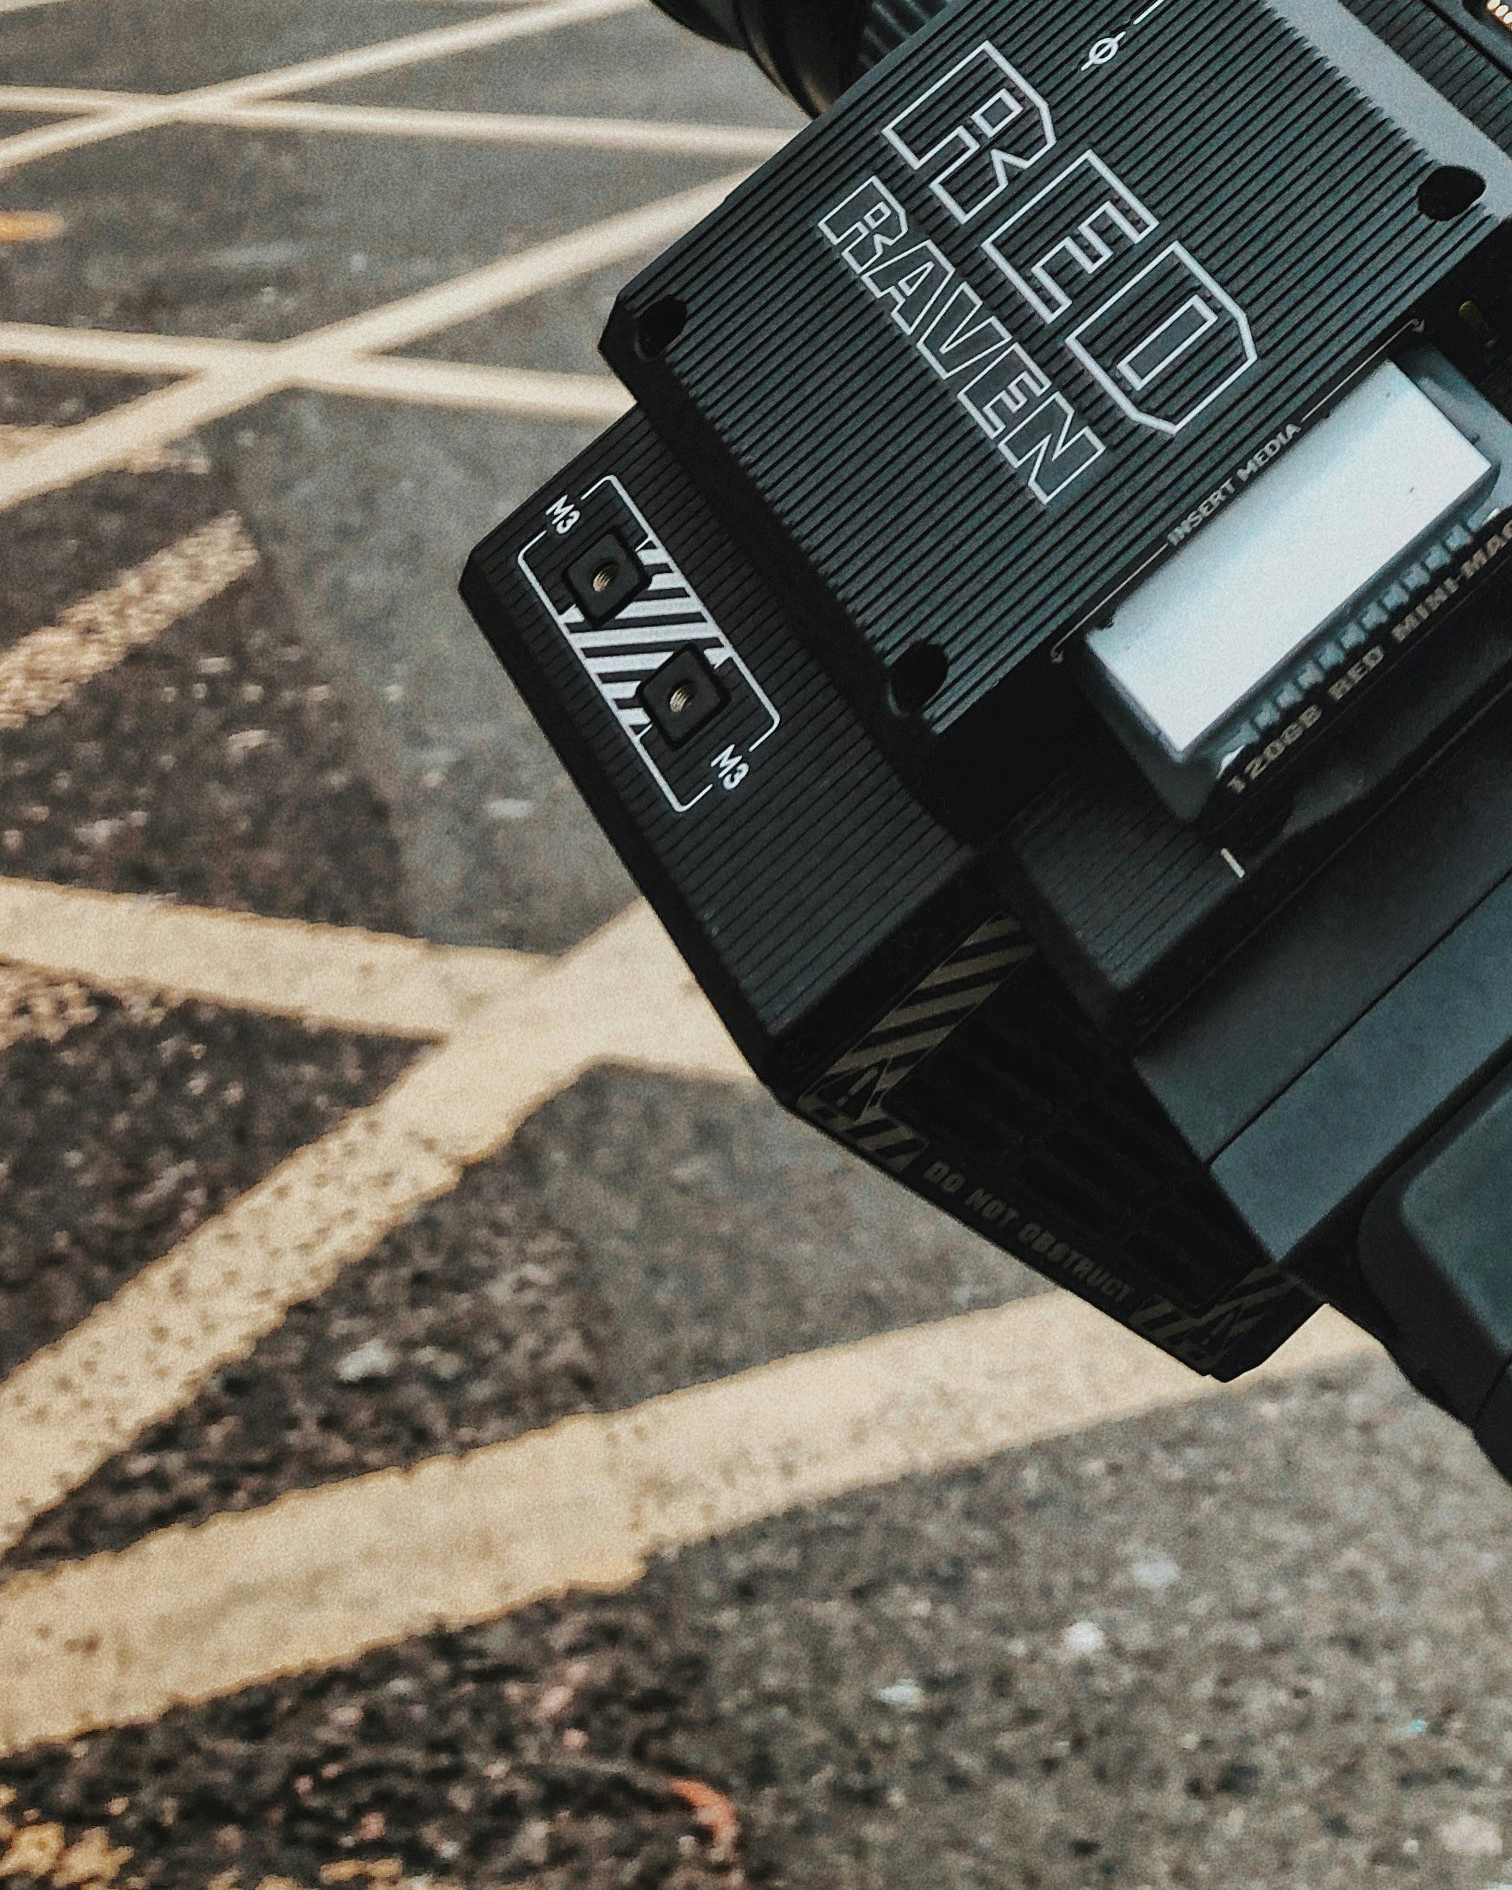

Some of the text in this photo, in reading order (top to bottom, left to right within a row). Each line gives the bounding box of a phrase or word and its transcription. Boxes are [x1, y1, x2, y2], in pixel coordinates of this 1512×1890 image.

[881, 39, 1258, 435] RED
[817, 175, 1107, 506] RAVEN
[545, 493, 582, 535] M3
[1167, 422, 1302, 547] INSERT MEDIA
[710, 743, 751, 791] M3
[1227, 704, 1324, 796] 120GB
[1327, 645, 1386, 702] RED
[923, 1161, 1136, 1305] DO NOT OBSTRUCT
